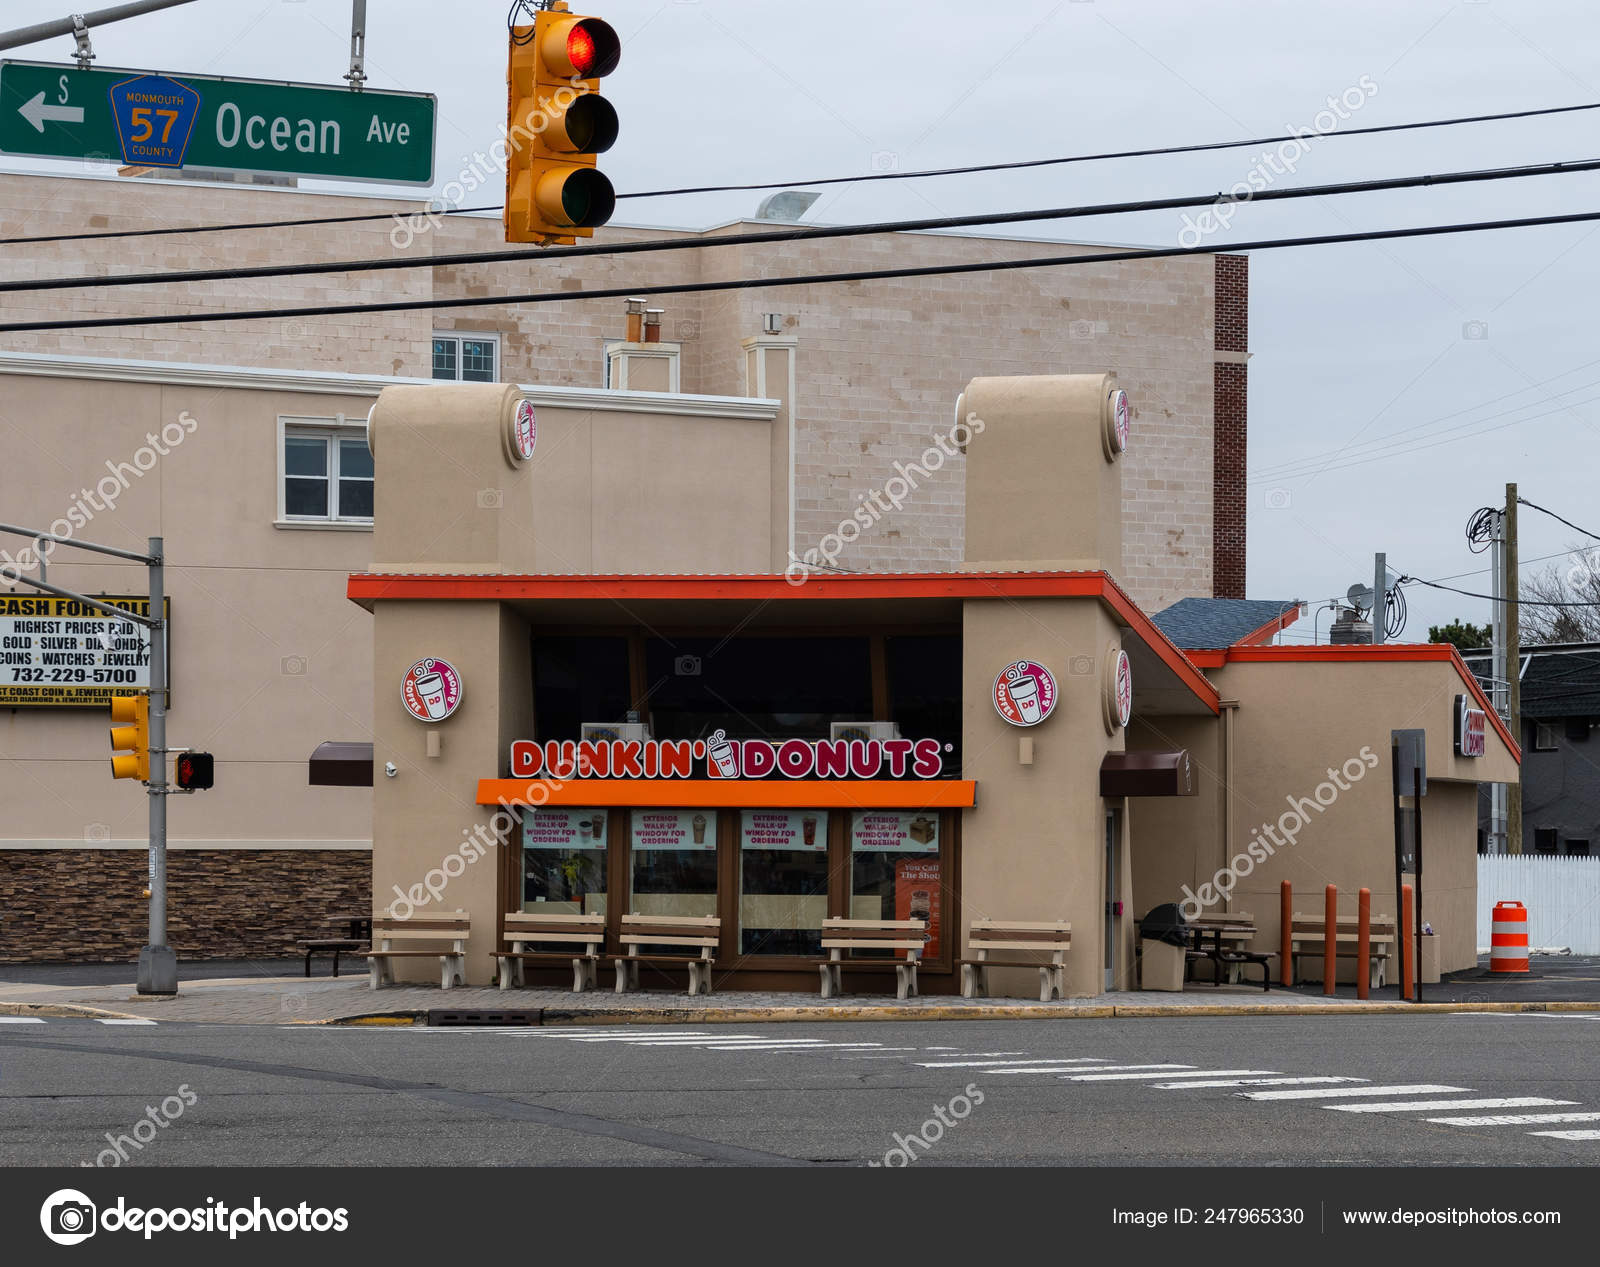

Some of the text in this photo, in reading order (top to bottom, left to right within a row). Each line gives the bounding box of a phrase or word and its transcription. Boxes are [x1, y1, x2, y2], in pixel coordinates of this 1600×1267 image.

[58, 75, 69, 104] S
[126, 92, 184, 106] MONMOUTH
[130, 107, 179, 144] 57
[215, 102, 410, 155] Ocean Ave
[132, 145, 174, 158] COUNTY
[56, 601, 95, 617] FOR
[14, 620, 61, 634] HIGHEST
[65, 621, 104, 635] PRICES
[3, 636, 144, 651] GOLD SILVER DIAONDS
[42, 652, 95, 666] WATCHES
[103, 653, 150, 667] JEWELRY
[11, 667, 137, 683] 732-229-5700
[9, 687, 40, 696] COAST
[42, 688, 65, 697] COIN
[75, 688, 114, 697] JEWELRY
[998, 683, 1015, 717] COFFEE
[510, 738, 942, 780] DUNKIN' DONUTS
[744, 829, 779, 837] WINDOW
[750, 837, 789, 845] ORDERING
[900, 871, 917, 879] The
